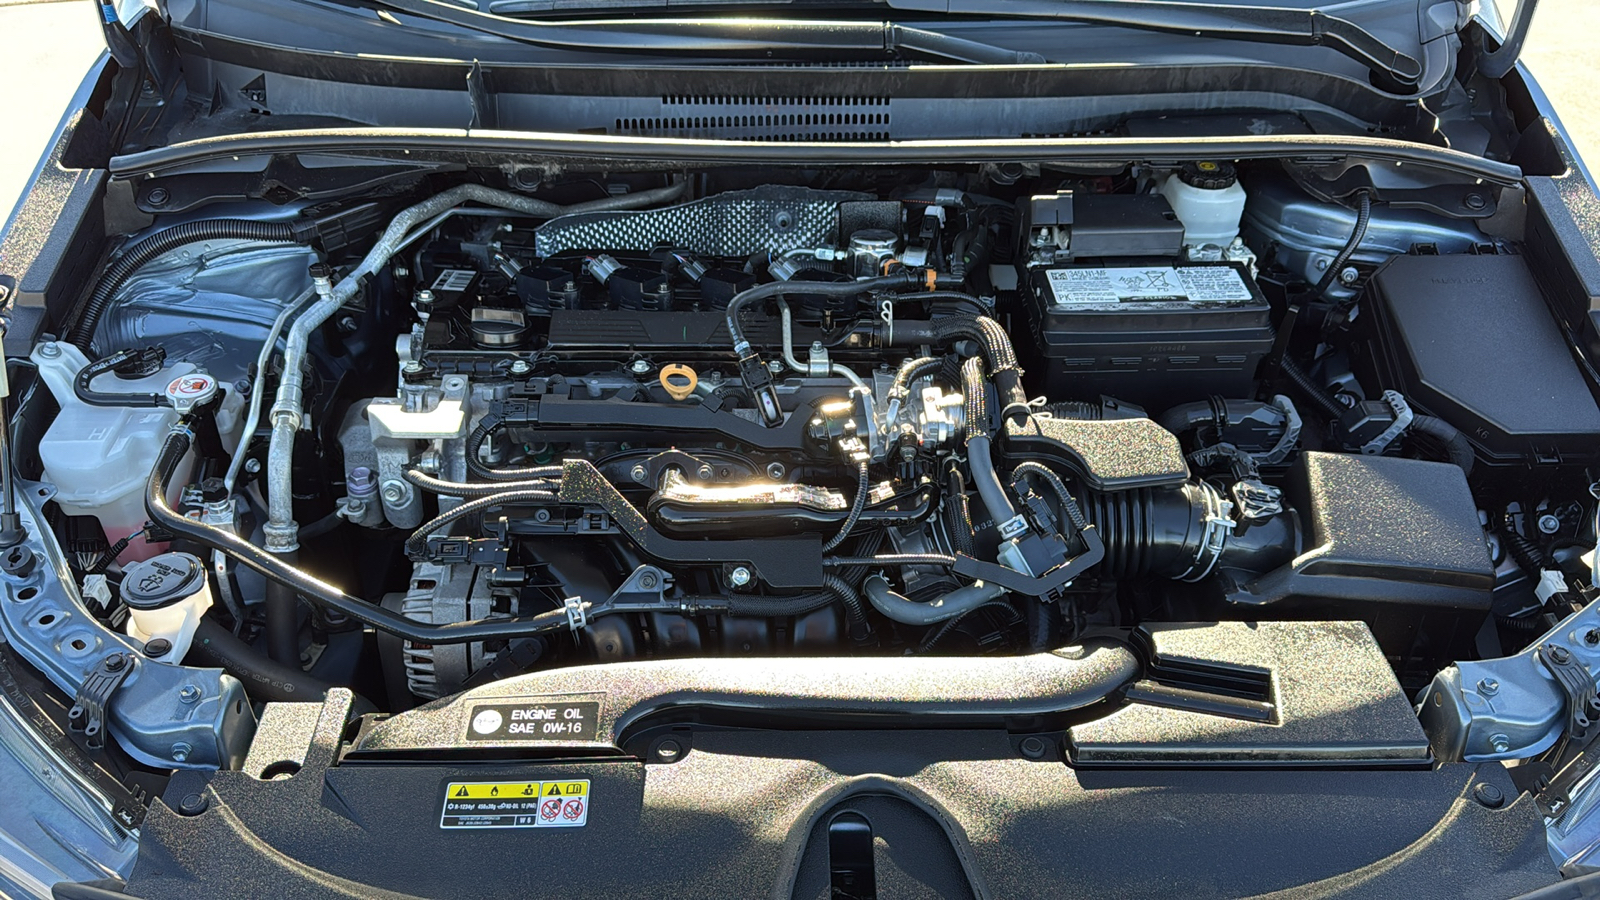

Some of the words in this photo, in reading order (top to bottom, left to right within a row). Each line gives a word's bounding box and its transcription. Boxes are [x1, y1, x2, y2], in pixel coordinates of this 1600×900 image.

[511, 709, 557, 720] ENGINE
[564, 708, 584, 719] OIL
[508, 723, 535, 733] SAE
[543, 722, 582, 733] 0W-16
